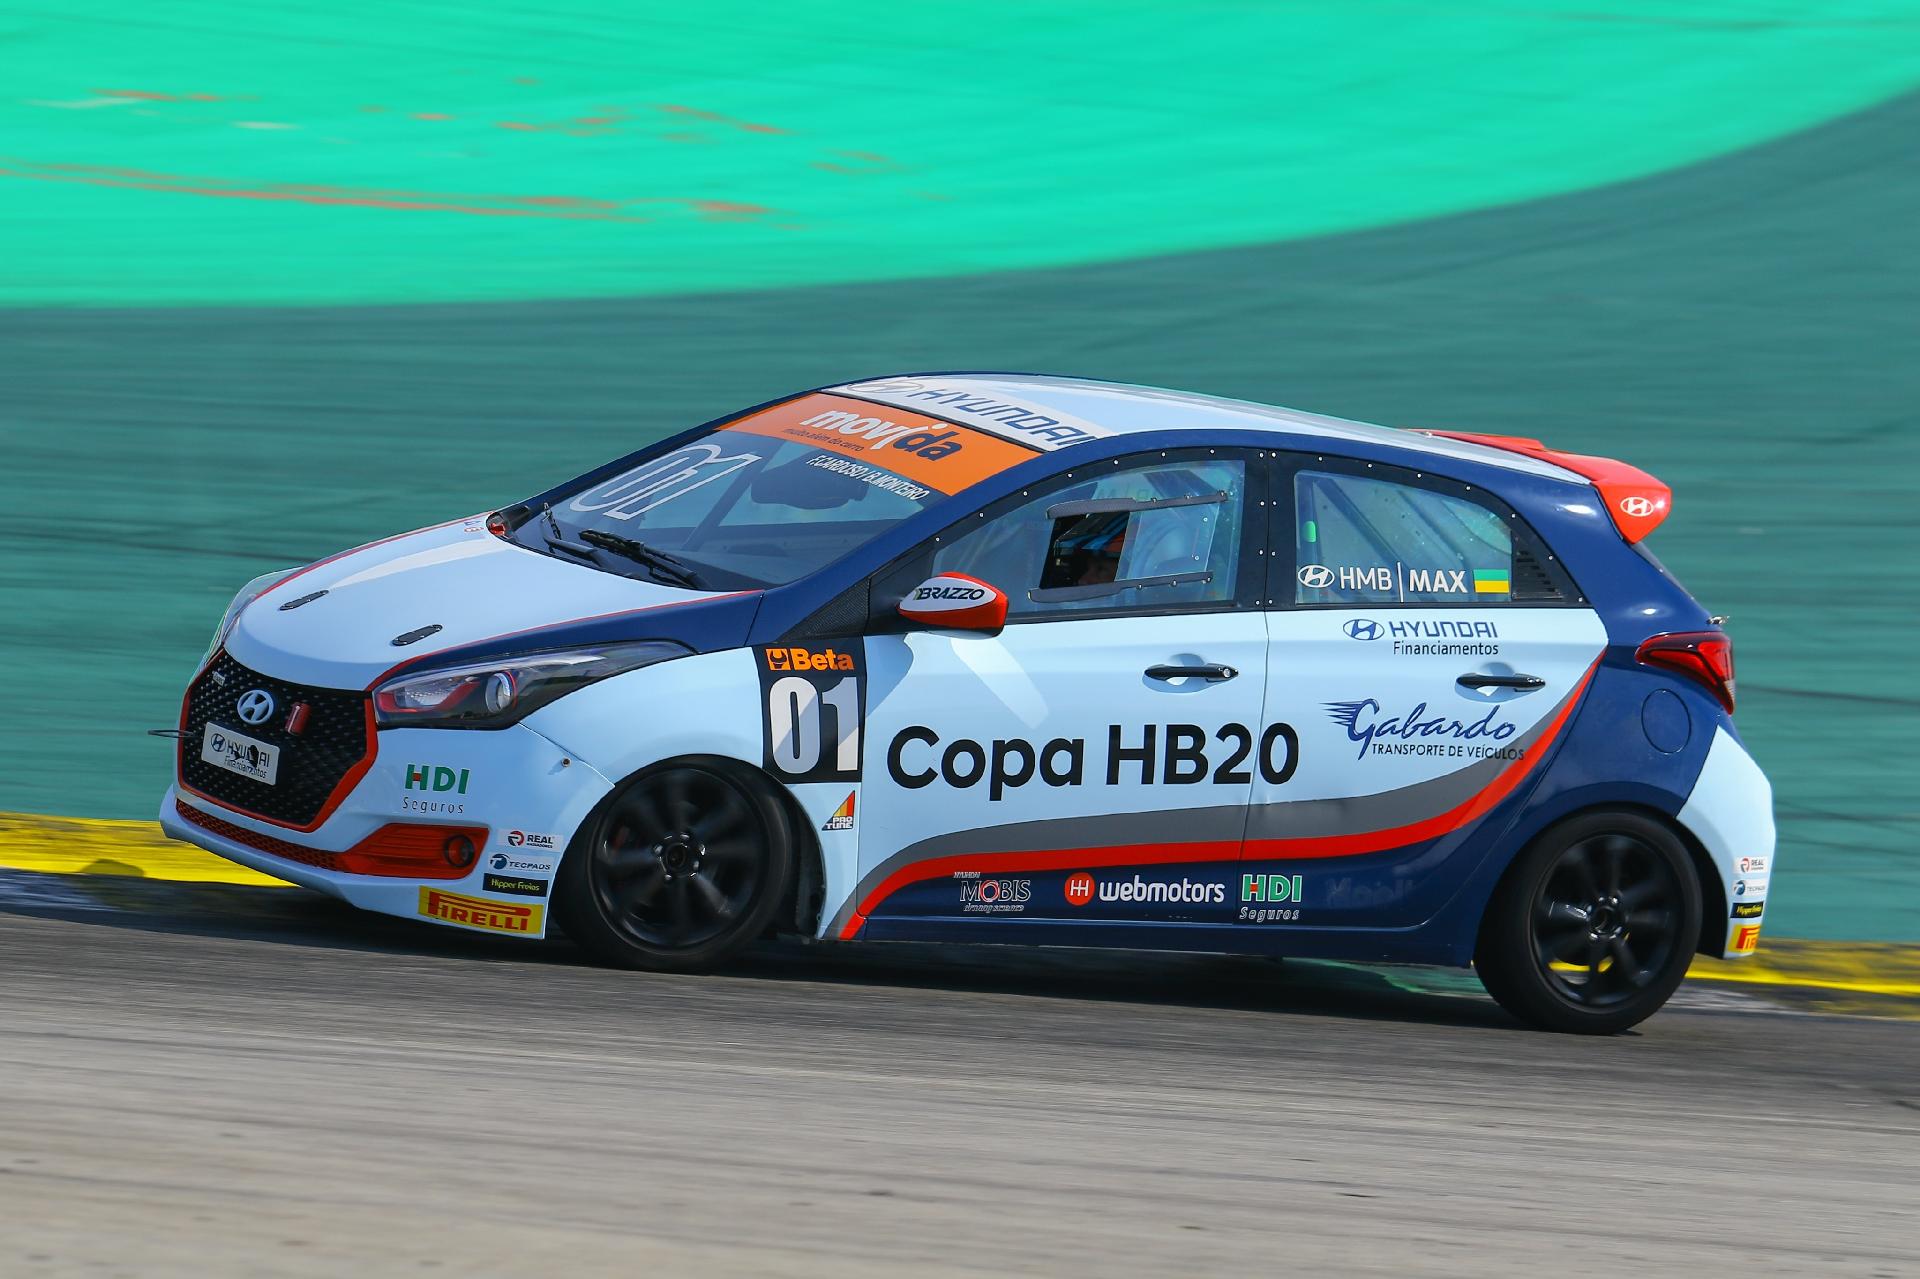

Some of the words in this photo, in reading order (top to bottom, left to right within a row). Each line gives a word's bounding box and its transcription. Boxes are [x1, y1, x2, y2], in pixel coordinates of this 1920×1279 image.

[906, 389, 1098, 446] HYUNDAI
[800, 410, 963, 462] movida
[569, 444, 763, 521] 01
[1339, 566, 1393, 591] HMB
[1409, 569, 1468, 593] MAX
[917, 587, 986, 601] BRAZZO
[1388, 620, 1499, 639] HYUNDAI
[789, 648, 855, 671] Beta
[1393, 641, 1499, 656] Financiamentos
[769, 676, 859, 774] 01
[1344, 698, 1516, 760] Gabardo
[227, 740, 270, 768] HYUAI
[887, 725, 1085, 802] Copa
[1105, 722, 1299, 786] HB20
[1372, 743, 1445, 757] TRANSPORTE
[1448, 745, 1464, 757] DE
[1466, 743, 1525, 761] VEÍCULOS
[404, 763, 470, 795] HDI
[402, 796, 464, 814] Seguros
[527, 834, 554, 844] REAL
[826, 822, 853, 830] TUNE
[509, 861, 551, 870] TECPADS
[959, 879, 1031, 903] MOBIS
[1099, 875, 1226, 903] webmotors
[1241, 874, 1303, 903] HDI
[427, 890, 532, 931] PIRELLI
[1239, 906, 1300, 923] Seguros
